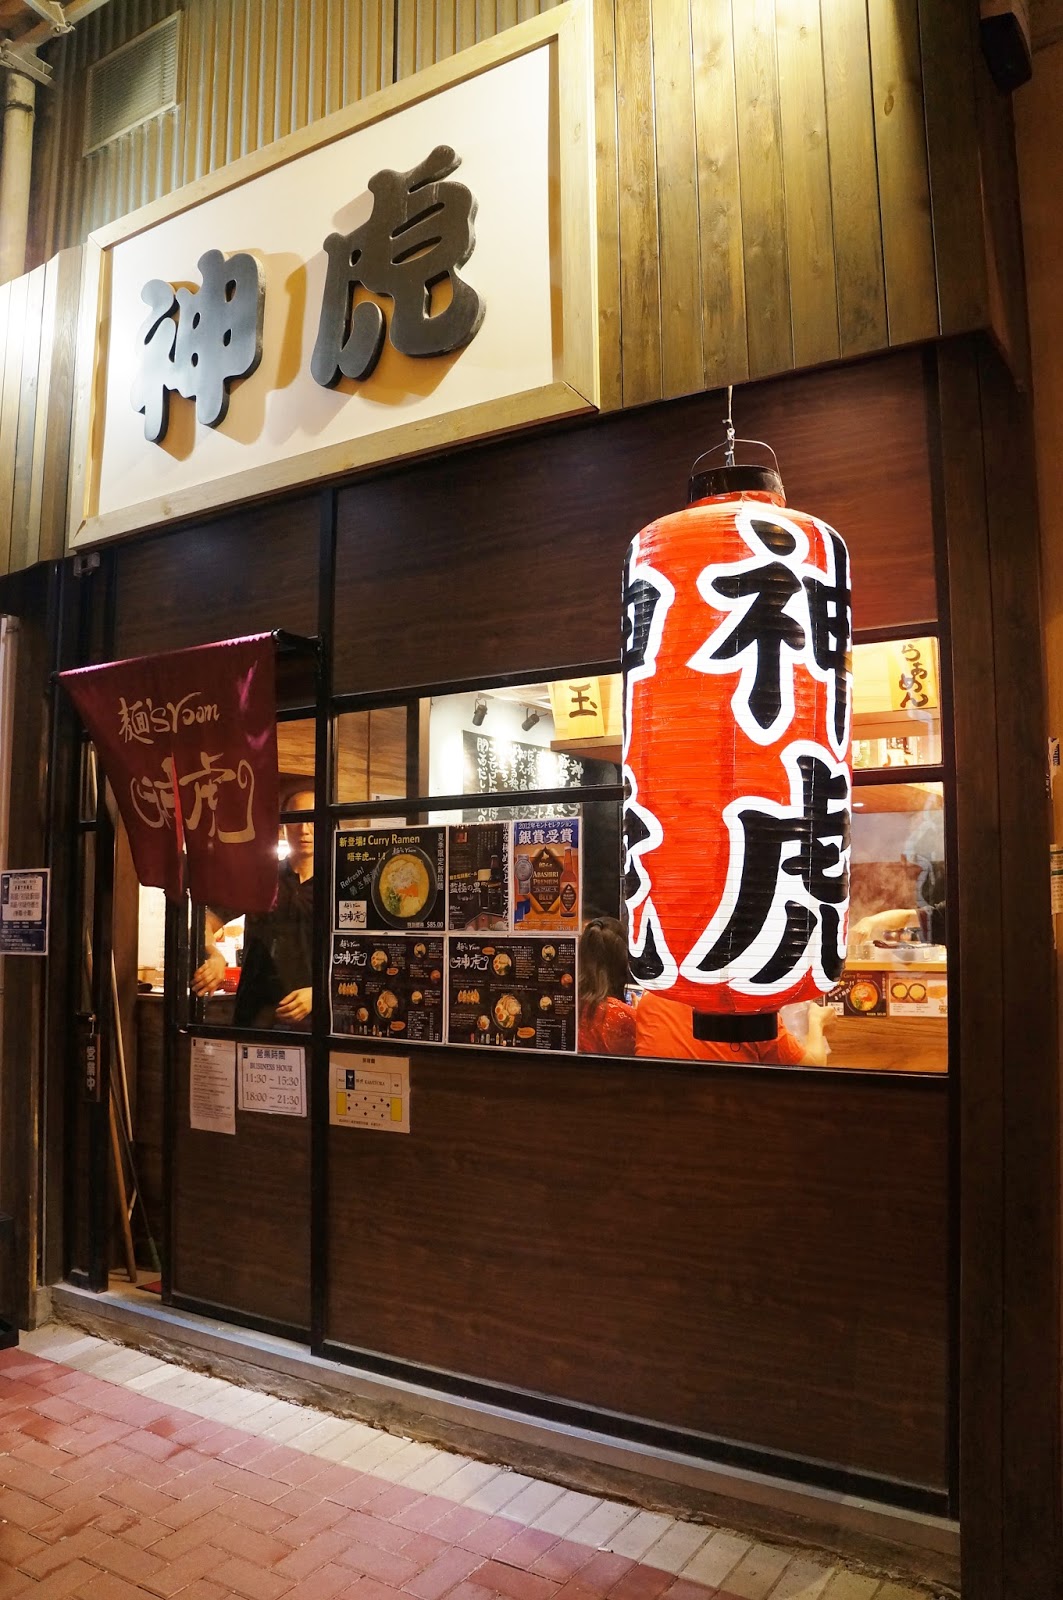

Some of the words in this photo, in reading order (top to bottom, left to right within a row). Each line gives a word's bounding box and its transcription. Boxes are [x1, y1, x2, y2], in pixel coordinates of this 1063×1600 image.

[131, 145, 486, 443] 神虎
[569, 684, 598, 719] 玉
[367, 834, 390, 846] Curry
[391, 833, 420, 844] Ramen
[518, 827, 574, 845] 銀賞受賞
[249, 1062, 276, 1071] BUSINESS
[276, 1064, 293, 1072] HOUR
[245, 1073, 267, 1084] 11:30
[277, 1076, 299, 1086] 15:30
[245, 1091, 267, 1102] 18:00
[277, 1095, 300, 1106] 21:30
